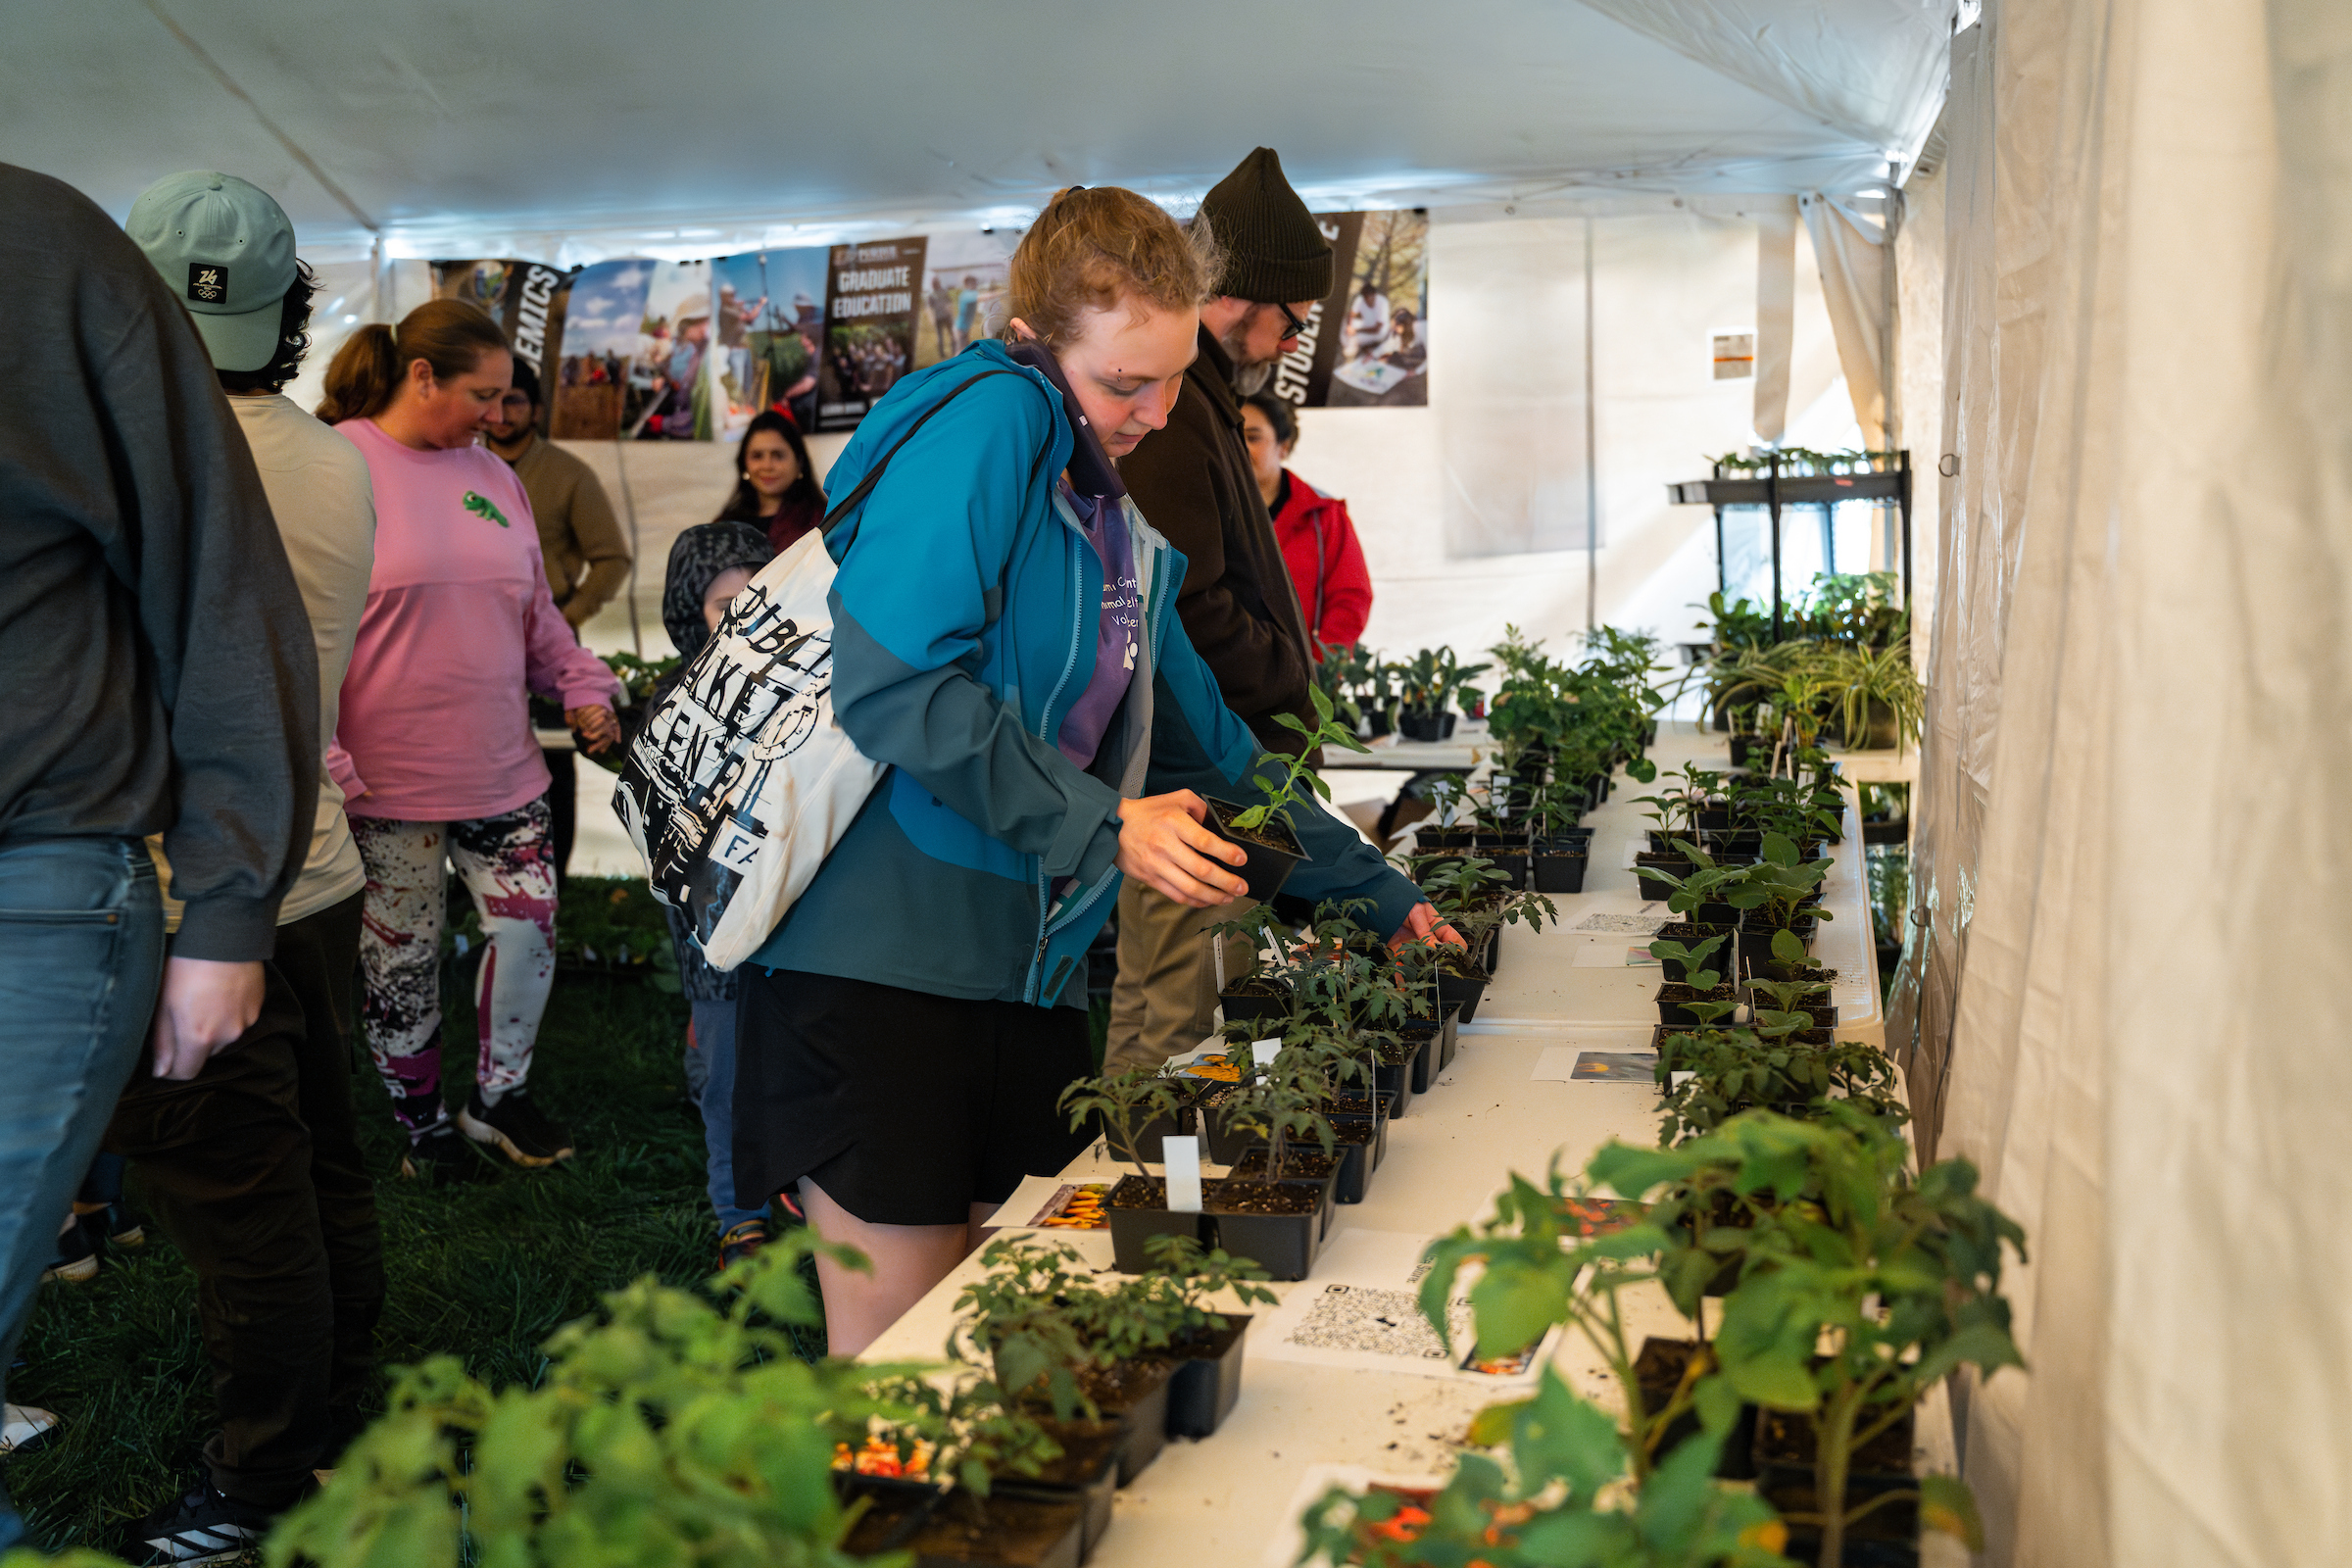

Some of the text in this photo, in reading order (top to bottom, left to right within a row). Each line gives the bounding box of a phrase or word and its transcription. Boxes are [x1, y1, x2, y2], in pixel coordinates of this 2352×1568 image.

[838, 266, 911, 293] GRADUATE
[831, 291, 912, 319] EDUCATION
[514, 265, 560, 378] EMICS
